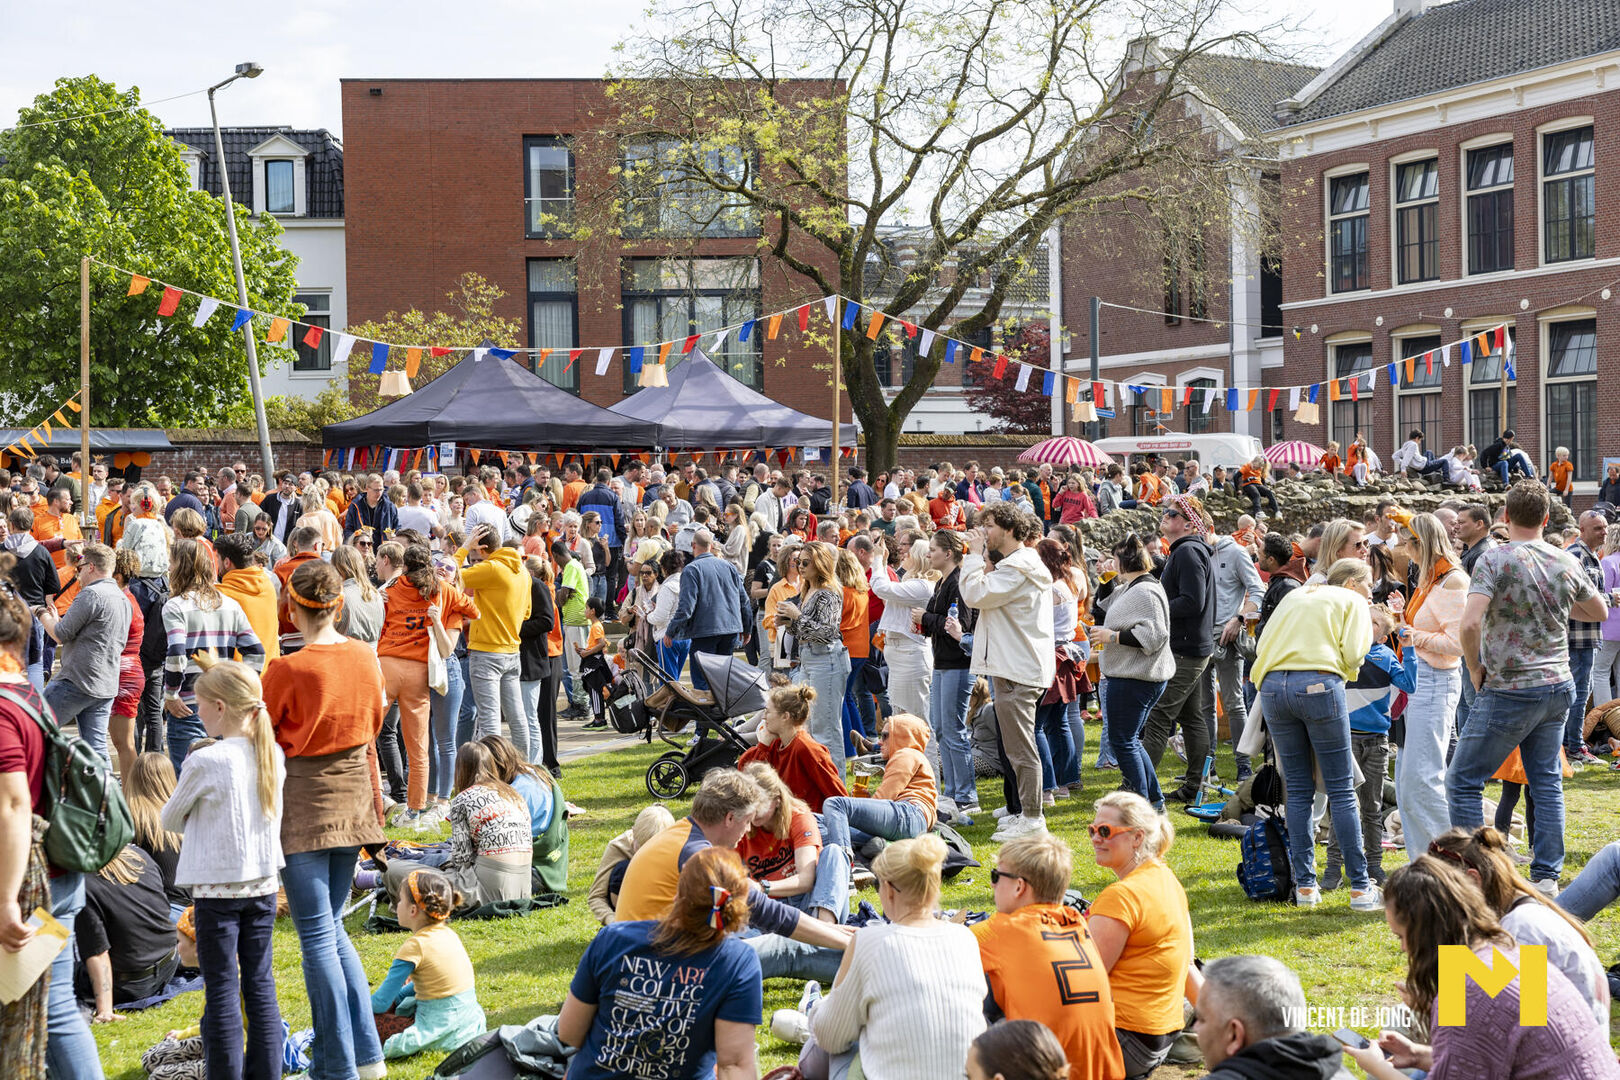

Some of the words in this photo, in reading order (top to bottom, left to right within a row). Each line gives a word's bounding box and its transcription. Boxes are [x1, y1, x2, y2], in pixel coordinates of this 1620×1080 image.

[405, 616, 425, 630] 51
[621, 954, 671, 979] NEW
[671, 966, 710, 985] ART
[1041, 930, 1100, 1005] 2
[630, 976, 704, 1002] COLLEC
[611, 1006, 665, 1031] CLASS
[667, 1017, 695, 1036] OF
[605, 1029, 645, 1062] TELL
[664, 1034, 690, 1050] 20
[597, 1045, 670, 1079] STORIES
[663, 1050, 686, 1066] 34
